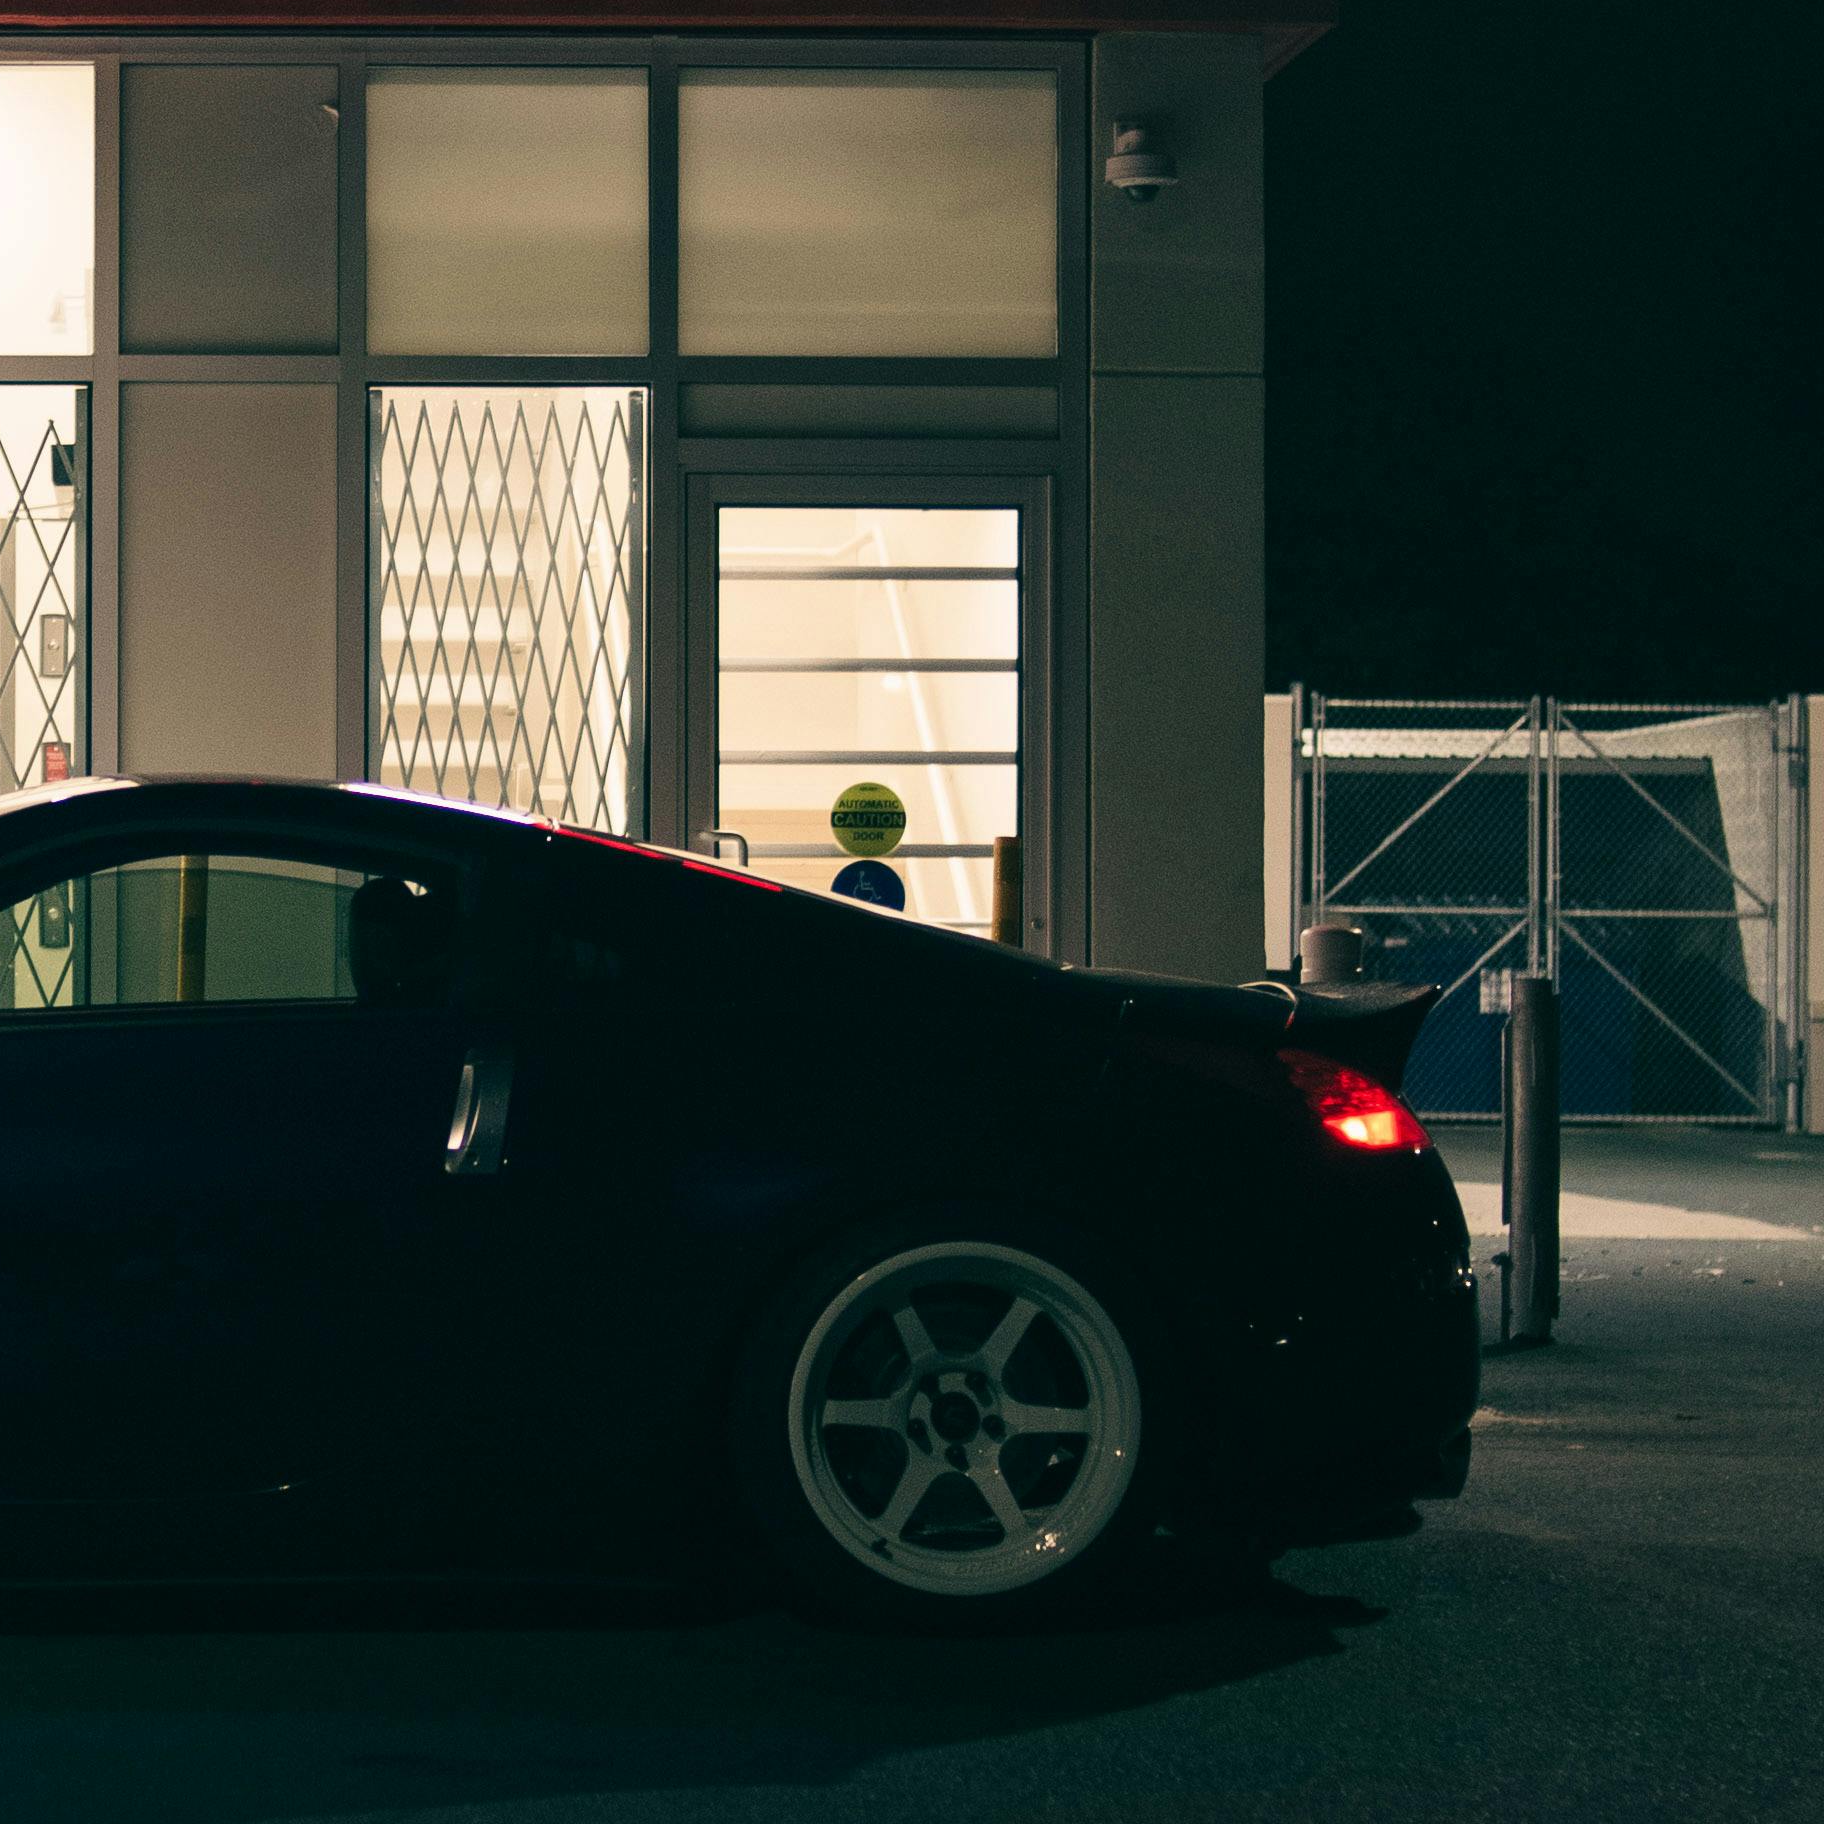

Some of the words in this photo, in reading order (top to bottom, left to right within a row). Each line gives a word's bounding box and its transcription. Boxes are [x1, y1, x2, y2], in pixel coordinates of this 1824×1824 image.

[838, 799, 899, 809] AUTOMATIC
[834, 814, 903, 826] CAUTION
[853, 831, 885, 841] DOOR
